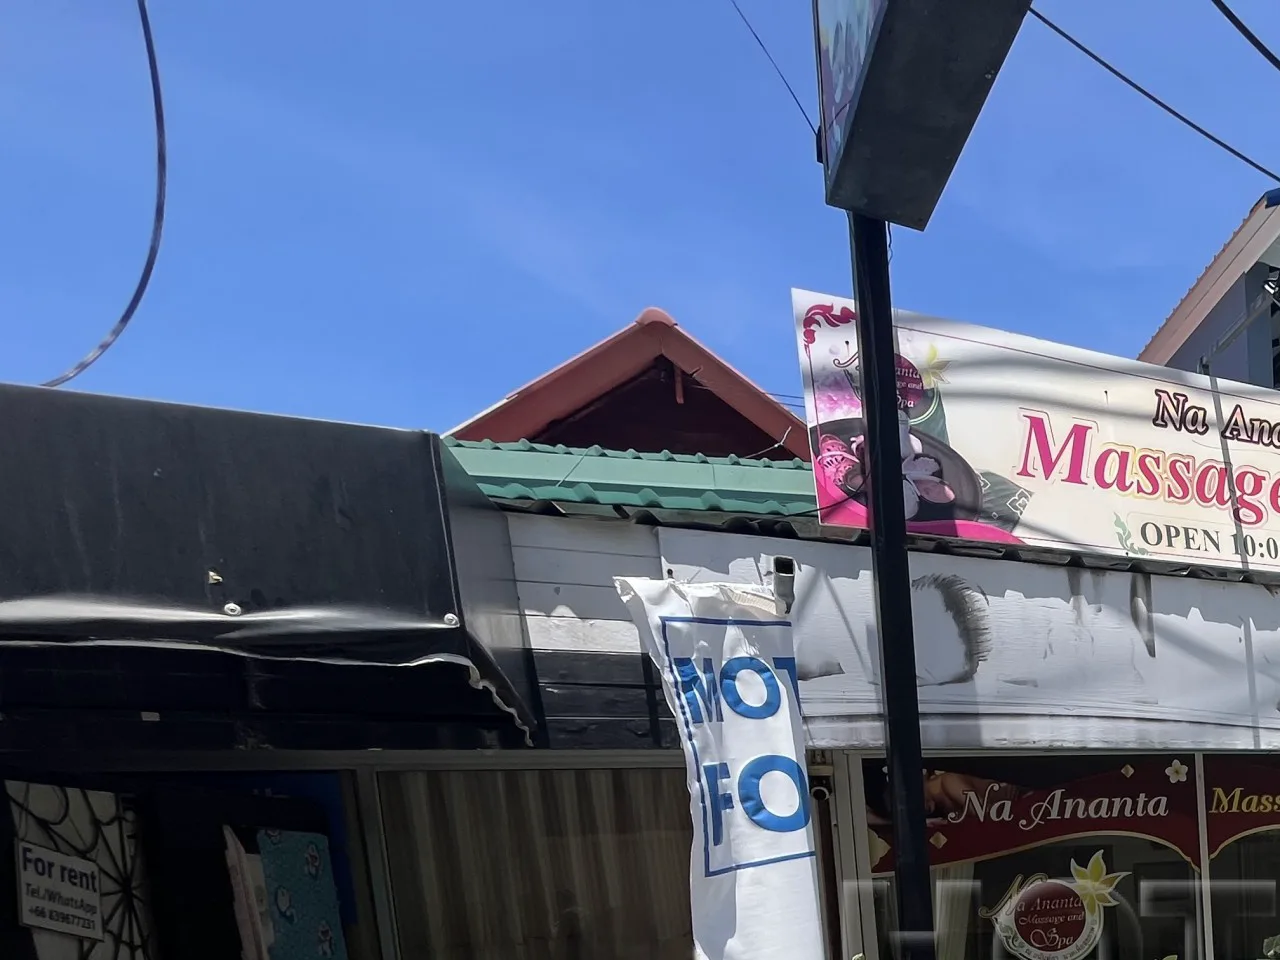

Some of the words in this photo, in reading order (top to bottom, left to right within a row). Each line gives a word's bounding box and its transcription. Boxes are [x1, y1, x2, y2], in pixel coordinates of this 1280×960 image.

[1152, 389, 1209, 434] Na
[1140, 521, 1220, 552] OPEN
[947, 783, 1014, 824] Na
[1018, 788, 1169, 831] Ananta
[23, 846, 55, 879] For
[60, 865, 97, 893] rent
[1030, 927, 1075, 949] Spa
